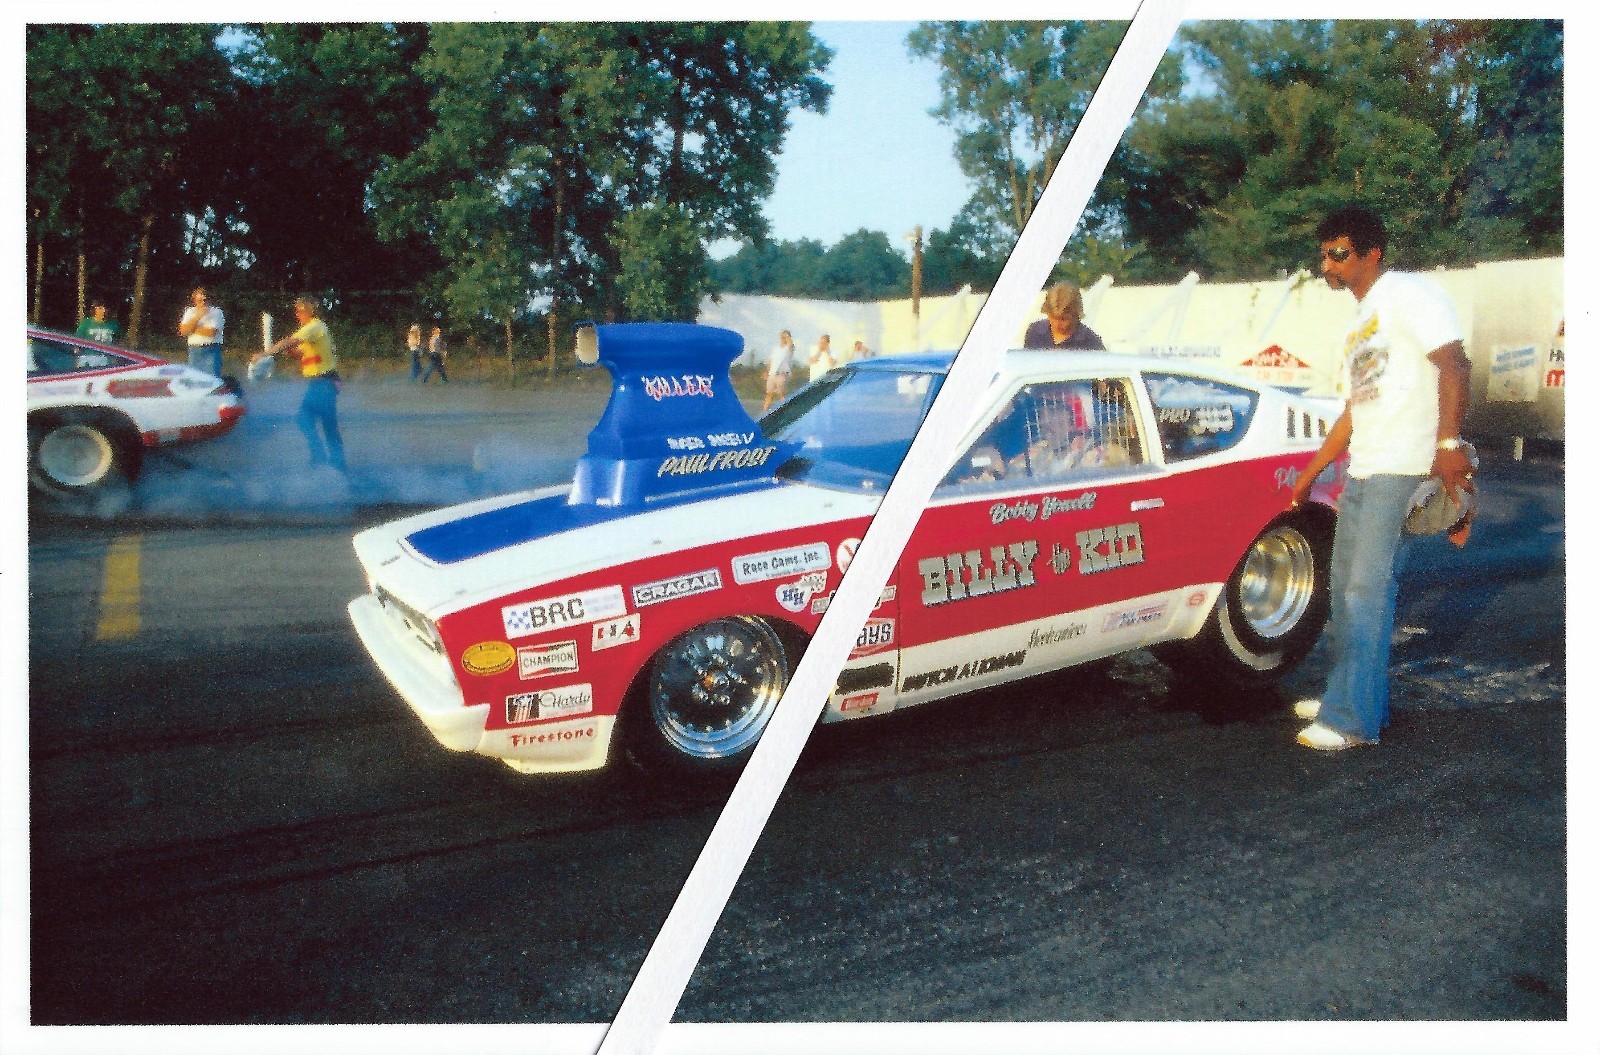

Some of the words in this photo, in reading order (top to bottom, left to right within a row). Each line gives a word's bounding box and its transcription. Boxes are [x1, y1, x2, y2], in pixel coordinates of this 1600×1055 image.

[657, 453, 710, 477] PAUL
[742, 561, 769, 576] Race
[918, 539, 1038, 608] BILLY
[1076, 521, 1146, 576] KID
[637, 574, 718, 603] CRAGAR
[530, 598, 584, 629] BRC
[523, 652, 574, 669] CHAMPION
[509, 727, 594, 748] Firestone
